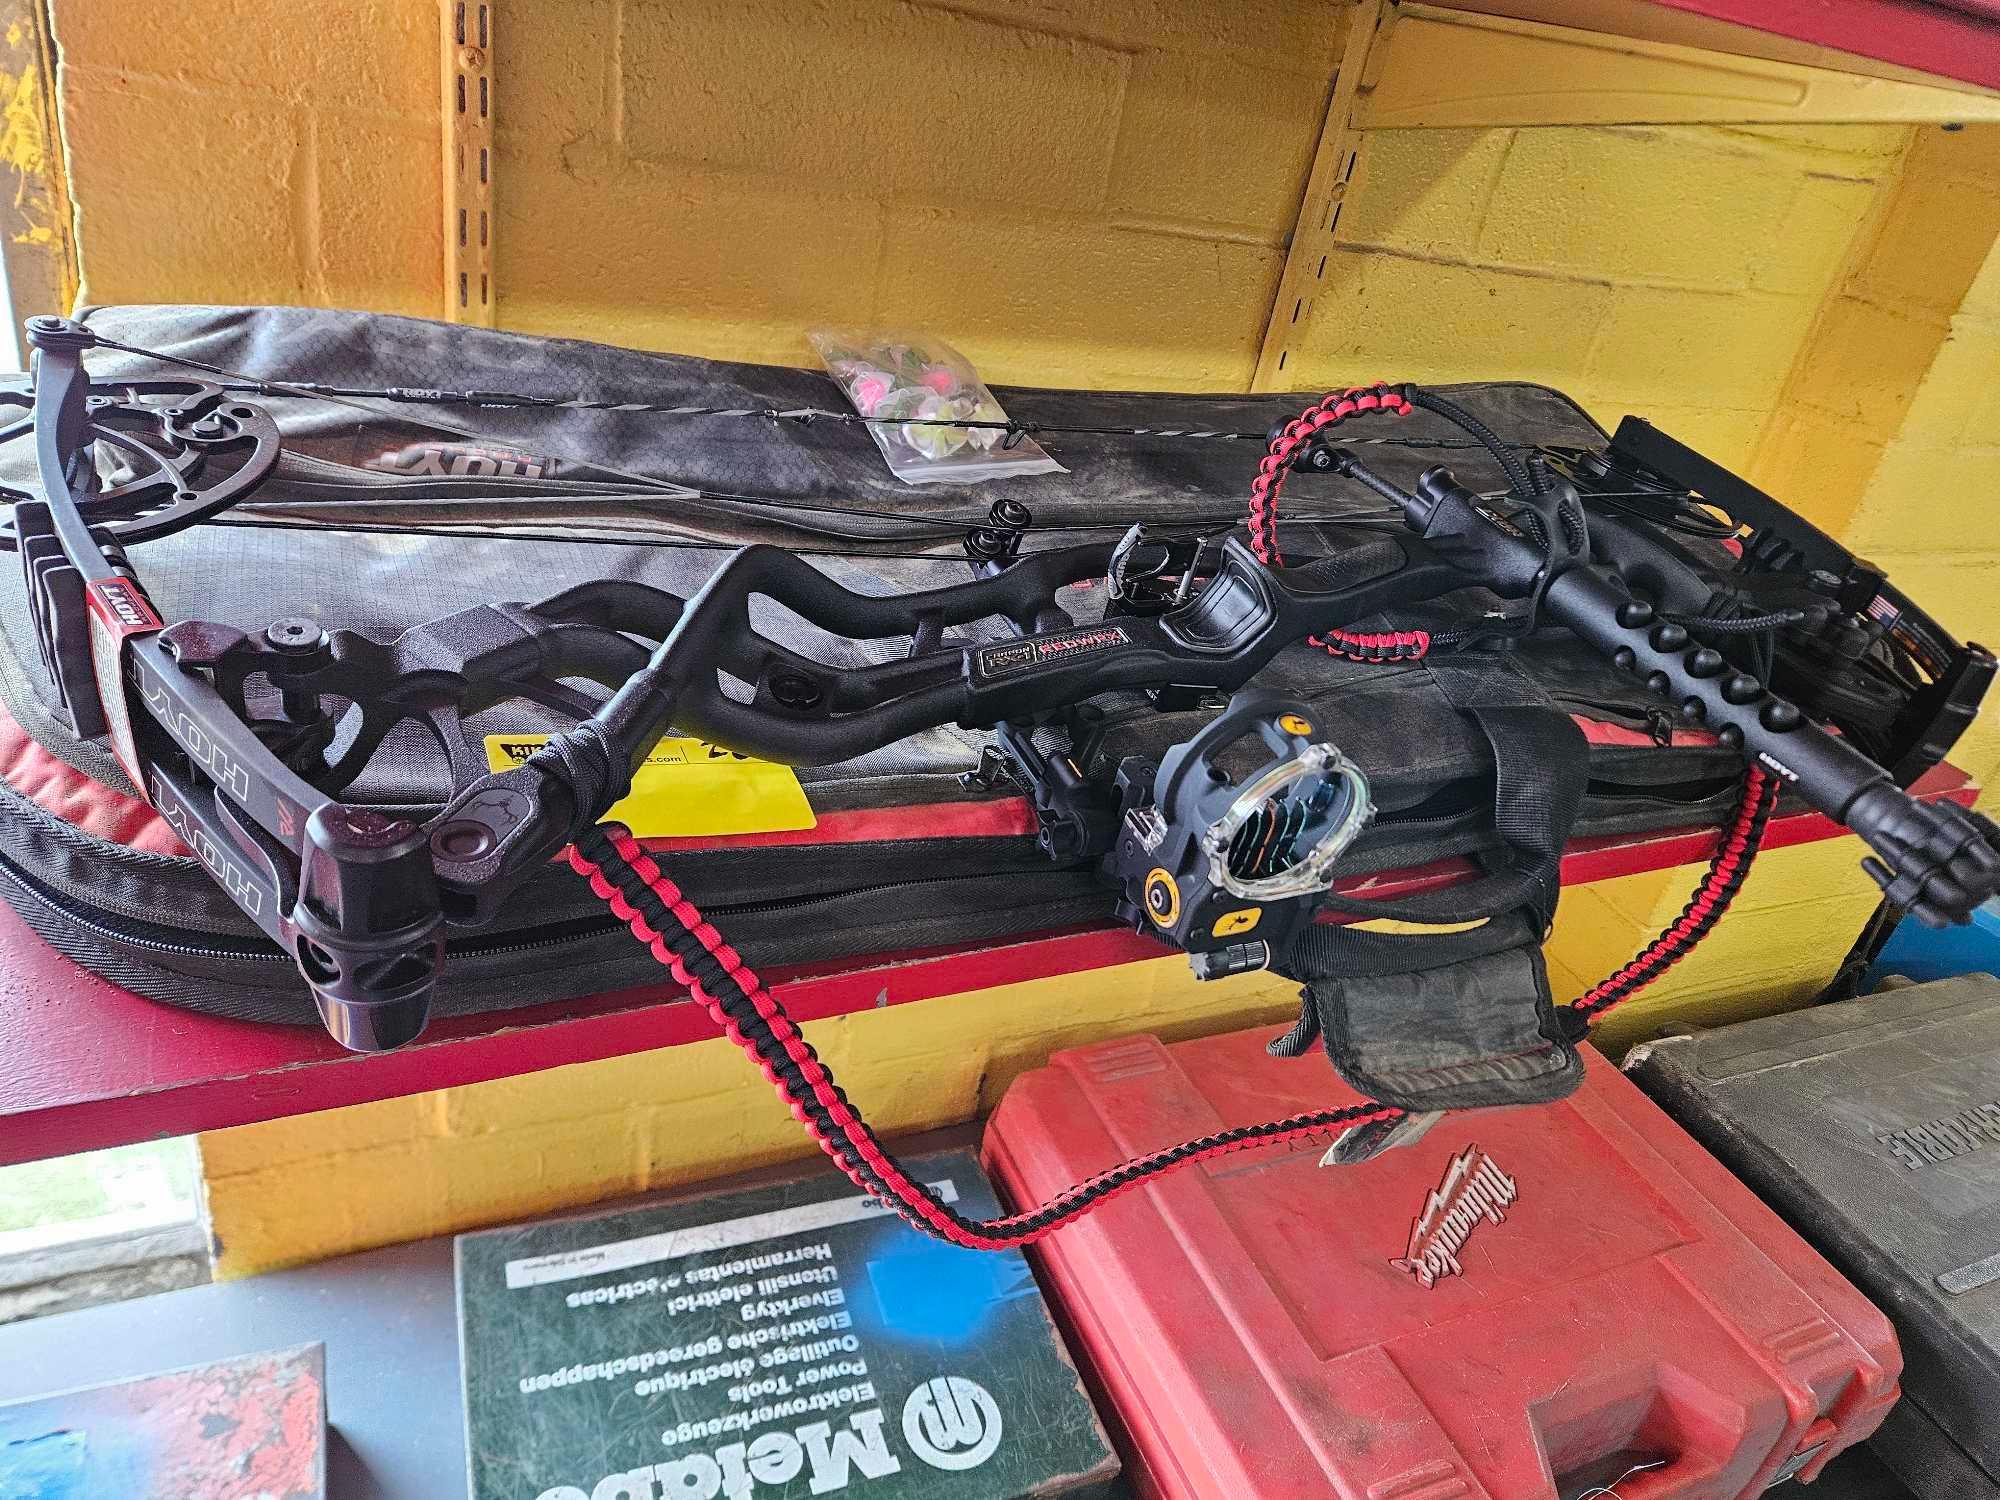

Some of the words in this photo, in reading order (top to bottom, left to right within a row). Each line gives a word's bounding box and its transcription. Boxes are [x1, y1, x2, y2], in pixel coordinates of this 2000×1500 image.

[100, 585, 144, 625] HOYT
[127, 656, 249, 802] HOYT
[151, 774, 262, 916] HOYT
[1389, 1152, 1518, 1290] Milwaukee
[684, 1241, 832, 1285] Herramientas
[757, 1265, 839, 1295] Utensili
[667, 1282, 754, 1317] elettrici
[740, 1288, 845, 1322] Elverktyg
[726, 1310, 853, 1350] Elektrische
[519, 1334, 723, 1394] gereedschappen
[758, 1334, 860, 1369] Outillage
[634, 1357, 756, 1397] électrique
[727, 1376, 793, 1404] Tools
[795, 1358, 869, 1388] Power
[660, 1380, 876, 1446] Elektrowerkzeuge
[533, 1408, 901, 1500] Metab
